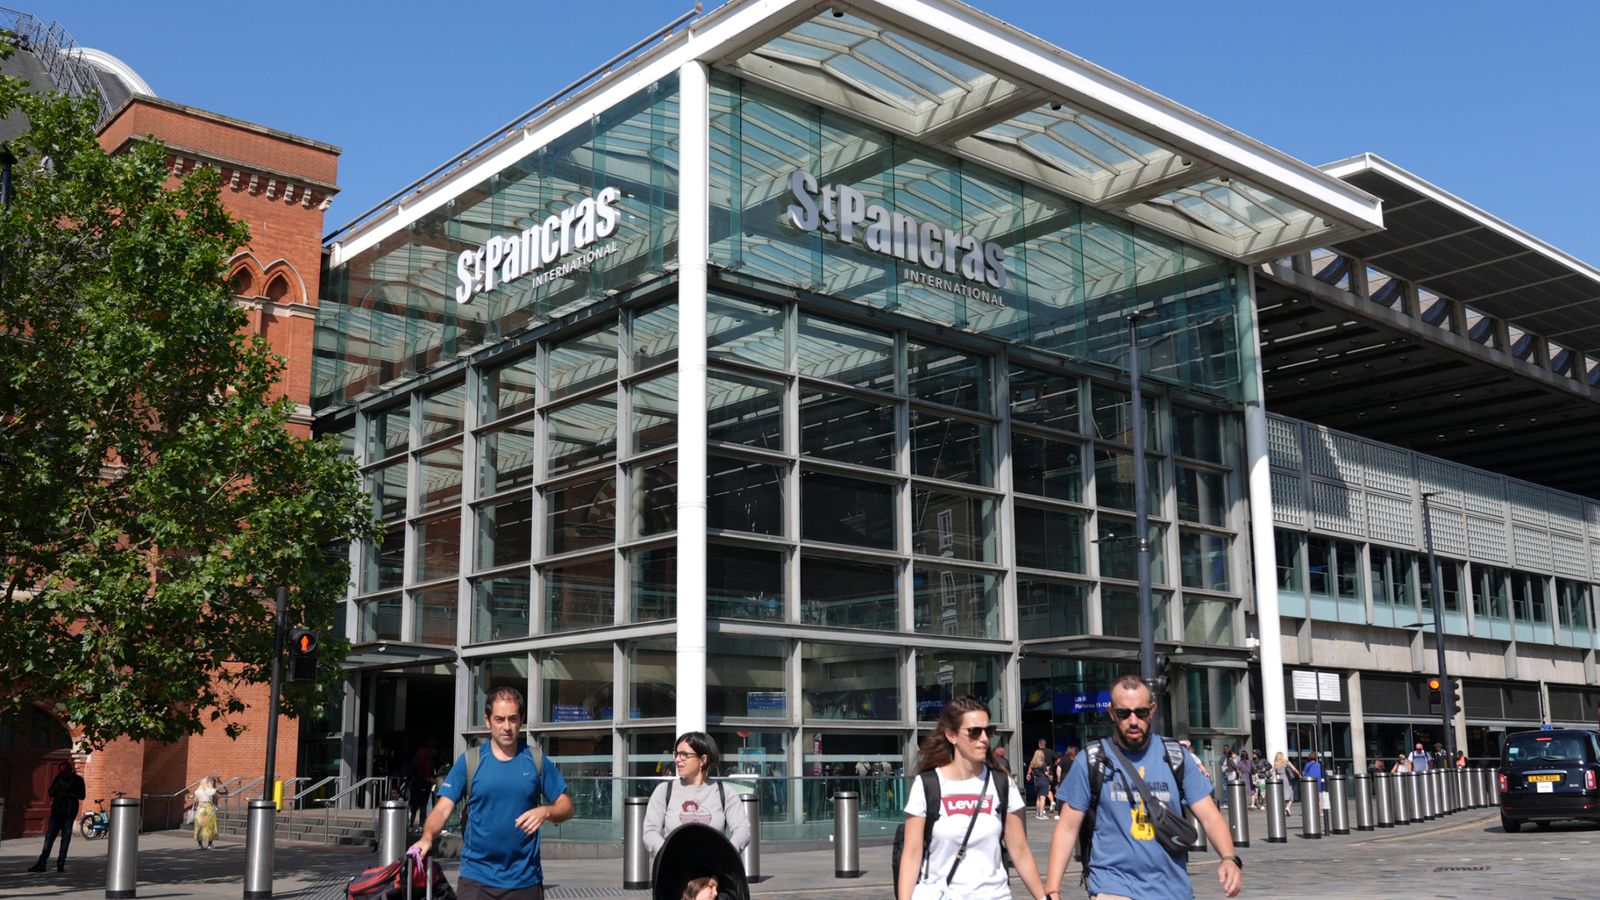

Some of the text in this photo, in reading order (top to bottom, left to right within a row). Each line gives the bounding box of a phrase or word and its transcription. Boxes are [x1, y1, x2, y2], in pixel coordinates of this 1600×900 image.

[485, 187, 621, 293] Pancras
[532, 241, 619, 289] INTERNATIONAL
[837, 183, 1008, 289] Pancras
[904, 268, 1006, 308] INTERNATIONAL
